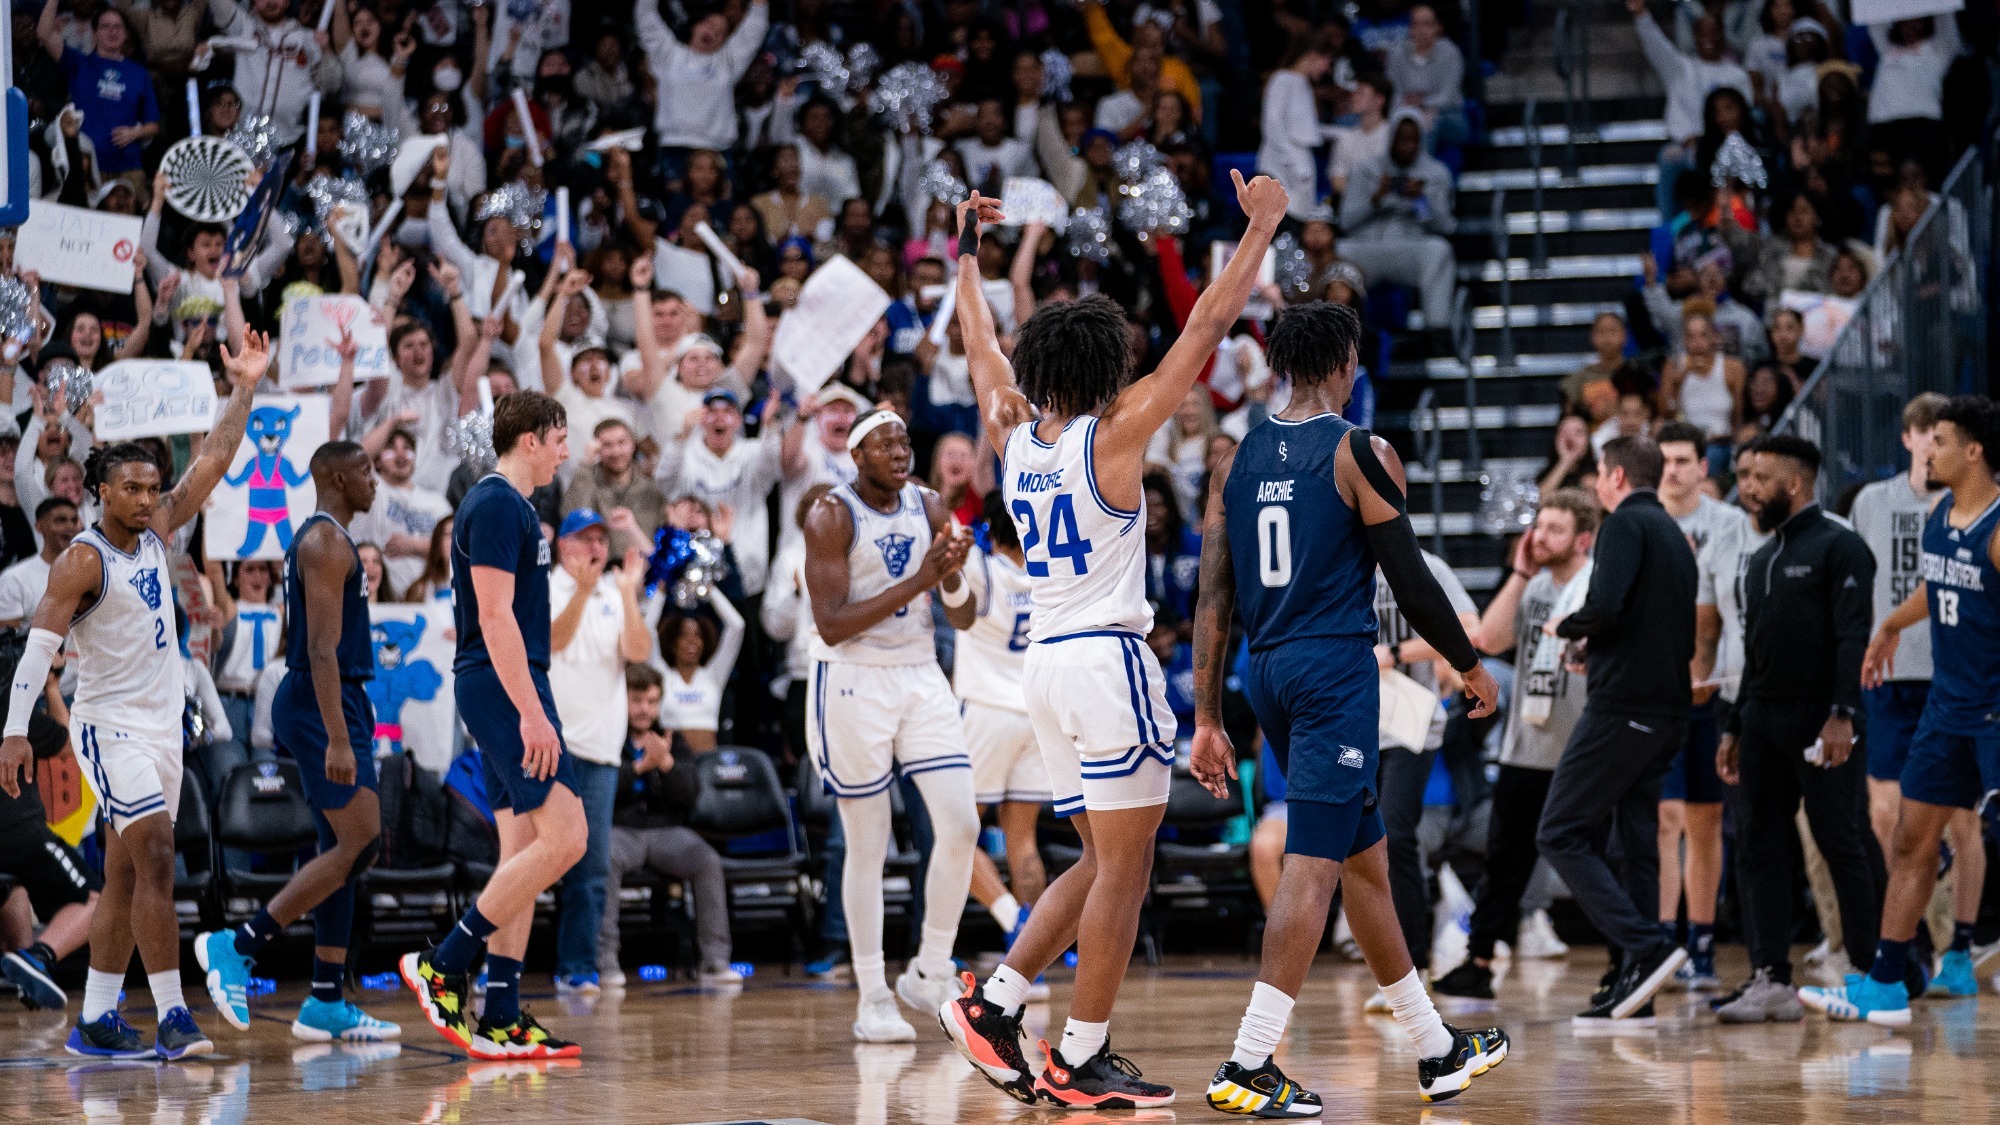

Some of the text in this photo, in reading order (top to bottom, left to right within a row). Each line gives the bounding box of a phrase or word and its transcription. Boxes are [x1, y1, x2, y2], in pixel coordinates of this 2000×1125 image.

[101, 366, 196, 400] GO
[104, 394, 211, 430] STATE
[1017, 467, 1064, 493] MOORE
[1256, 479, 1295, 503] ARCHIE
[1011, 493, 1093, 578] 24
[1892, 511, 1919, 533] THIS
[1257, 505, 1292, 588] 0
[1892, 538, 1918, 572] IS
[1937, 588, 1960, 628] 13
[154, 616, 167, 651] 2
